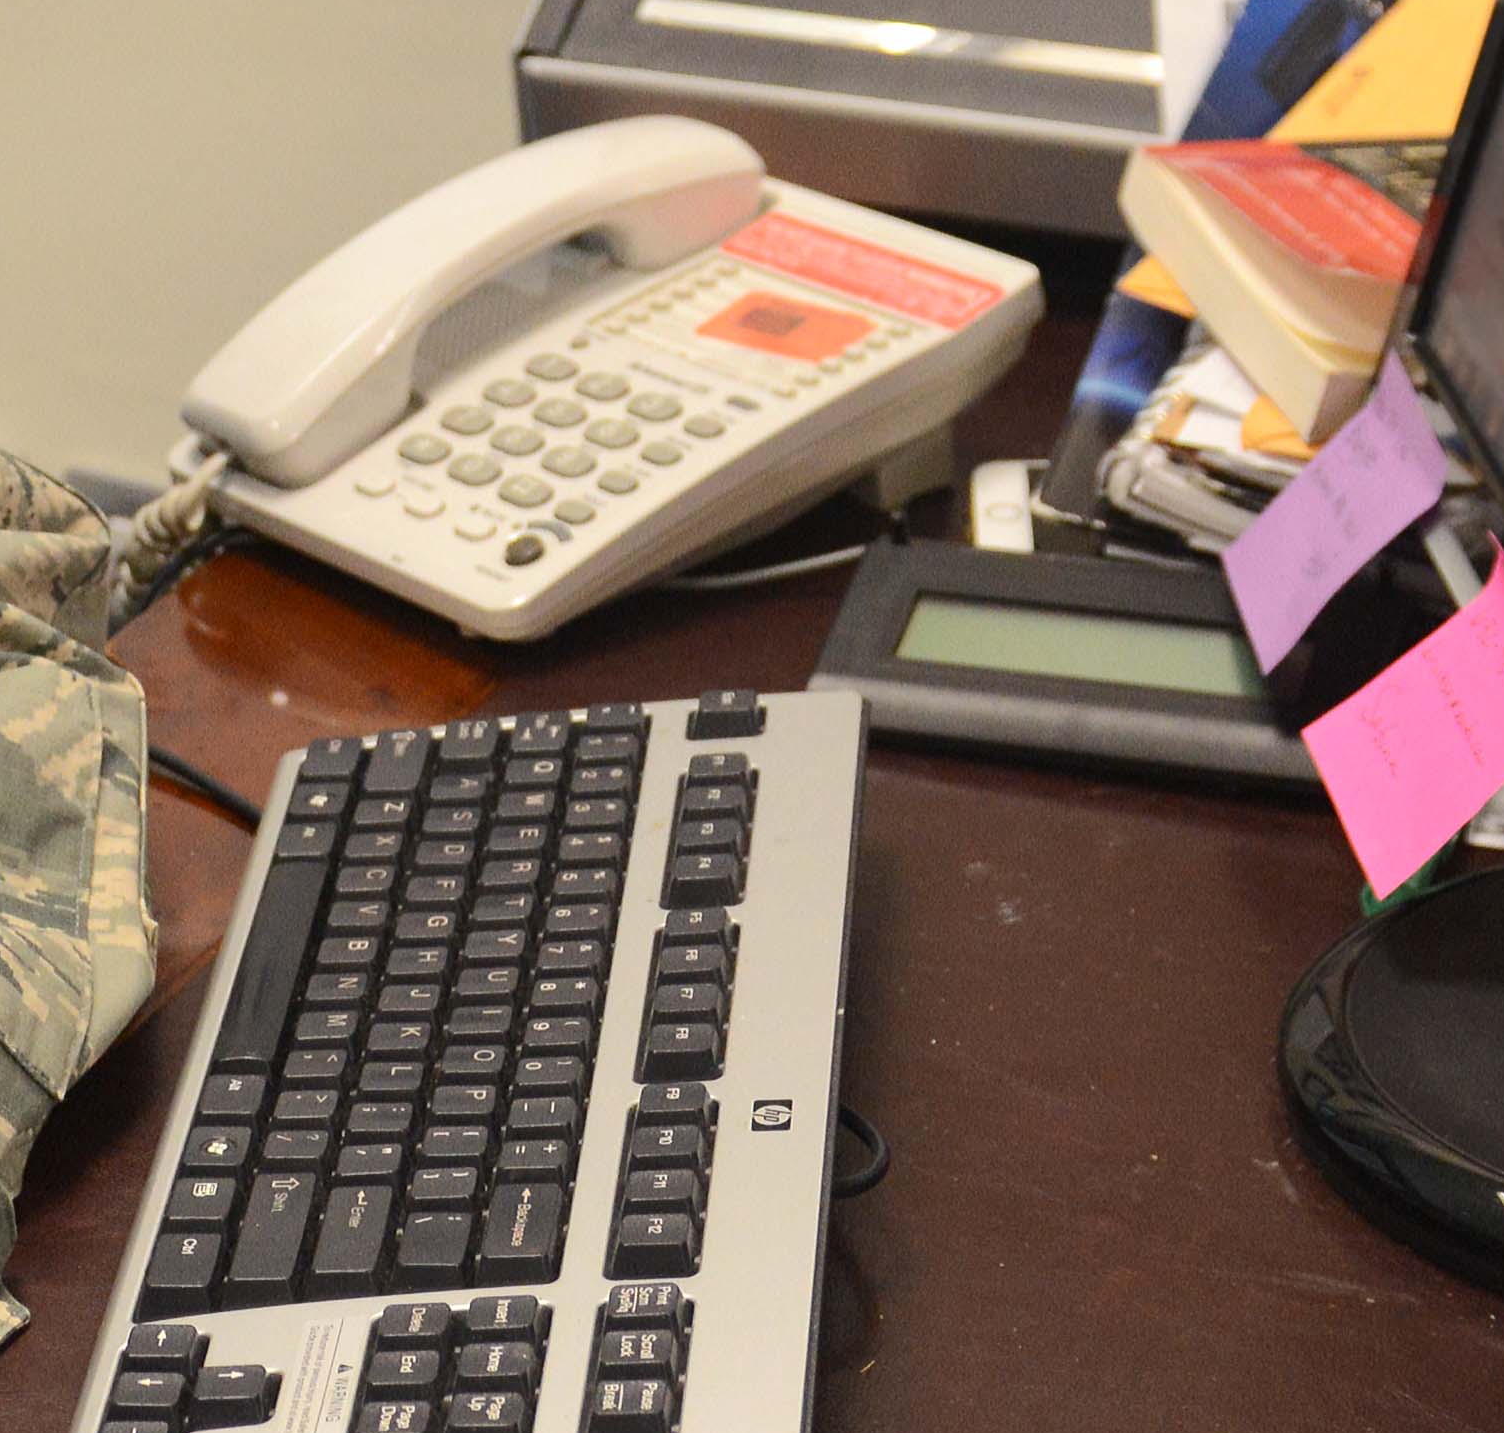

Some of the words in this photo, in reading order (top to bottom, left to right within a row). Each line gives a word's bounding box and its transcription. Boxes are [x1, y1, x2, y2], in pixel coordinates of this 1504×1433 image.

[533, 760, 554, 773] Q
[581, 770, 598, 779] 2
[460, 778, 479, 789] A
[525, 793, 545, 806] W
[383, 801, 405, 813] Z
[574, 803, 591, 813] 3
[452, 811, 473, 821] S
[520, 828, 539, 839] E
[376, 835, 396, 846] X
[569, 837, 584, 846] 4
[444, 844, 465, 855] D
[512, 861, 532, 873] R
[698, 857, 712, 869] F4
[366, 868, 388, 880] C
[562, 872, 578, 881] 5
[436, 879, 456, 889] F
[505, 897, 525, 907] T
[359, 904, 379, 915] V
[555, 909, 572, 918] 6
[427, 915, 449, 928] G
[689, 911, 703, 923] F5
[348, 940, 369, 951] B
[497, 933, 518, 945] Y
[548, 945, 564, 954] 7
[685, 948, 699, 961] F6
[418, 950, 439, 963] H
[487, 970, 509, 982] U
[338, 977, 359, 989] N
[540, 982, 557, 991] 8
[410, 988, 431, 998] J
[680, 987, 694, 1000] F7
[326, 1014, 348, 1027] M
[533, 1022, 550, 1031] 9
[400, 1026, 422, 1038] K
[675, 1027, 690, 1040] F8
[473, 1049, 496, 1062] O
[390, 1065, 413, 1076] L
[525, 1061, 542, 1071] 0
[228, 1078, 243, 1091] Alt
[468, 1089, 487, 1100] P
[666, 1087, 681, 1100] F9
[658, 1129, 674, 1145] F10
[653, 1173, 668, 1189] F11
[270, 1191, 289, 1213] Shift
[348, 1206, 365, 1229] Enter
[510, 1203, 532, 1247] Backspace
[647, 1217, 663, 1234] F12
[181, 1238, 198, 1255] Ctrl
[616, 1287, 635, 1313] SysRq
[636, 1286, 651, 1312] Scrn
[656, 1285, 672, 1306] Print
[495, 1299, 512, 1324] Insert
[410, 1307, 427, 1333] Delete
[620, 1334, 634, 1357] Lock
[640, 1333, 654, 1359] Scroll
[399, 1355, 417, 1373] End
[486, 1345, 504, 1372] Home
[602, 1383, 617, 1410] Break
[640, 1382, 659, 1411] Pause
[467, 1396, 486, 1412] Up
[485, 1395, 506, 1421] Page
[378, 1405, 397, 1432] Down
[394, 1404, 416, 1429] Page
